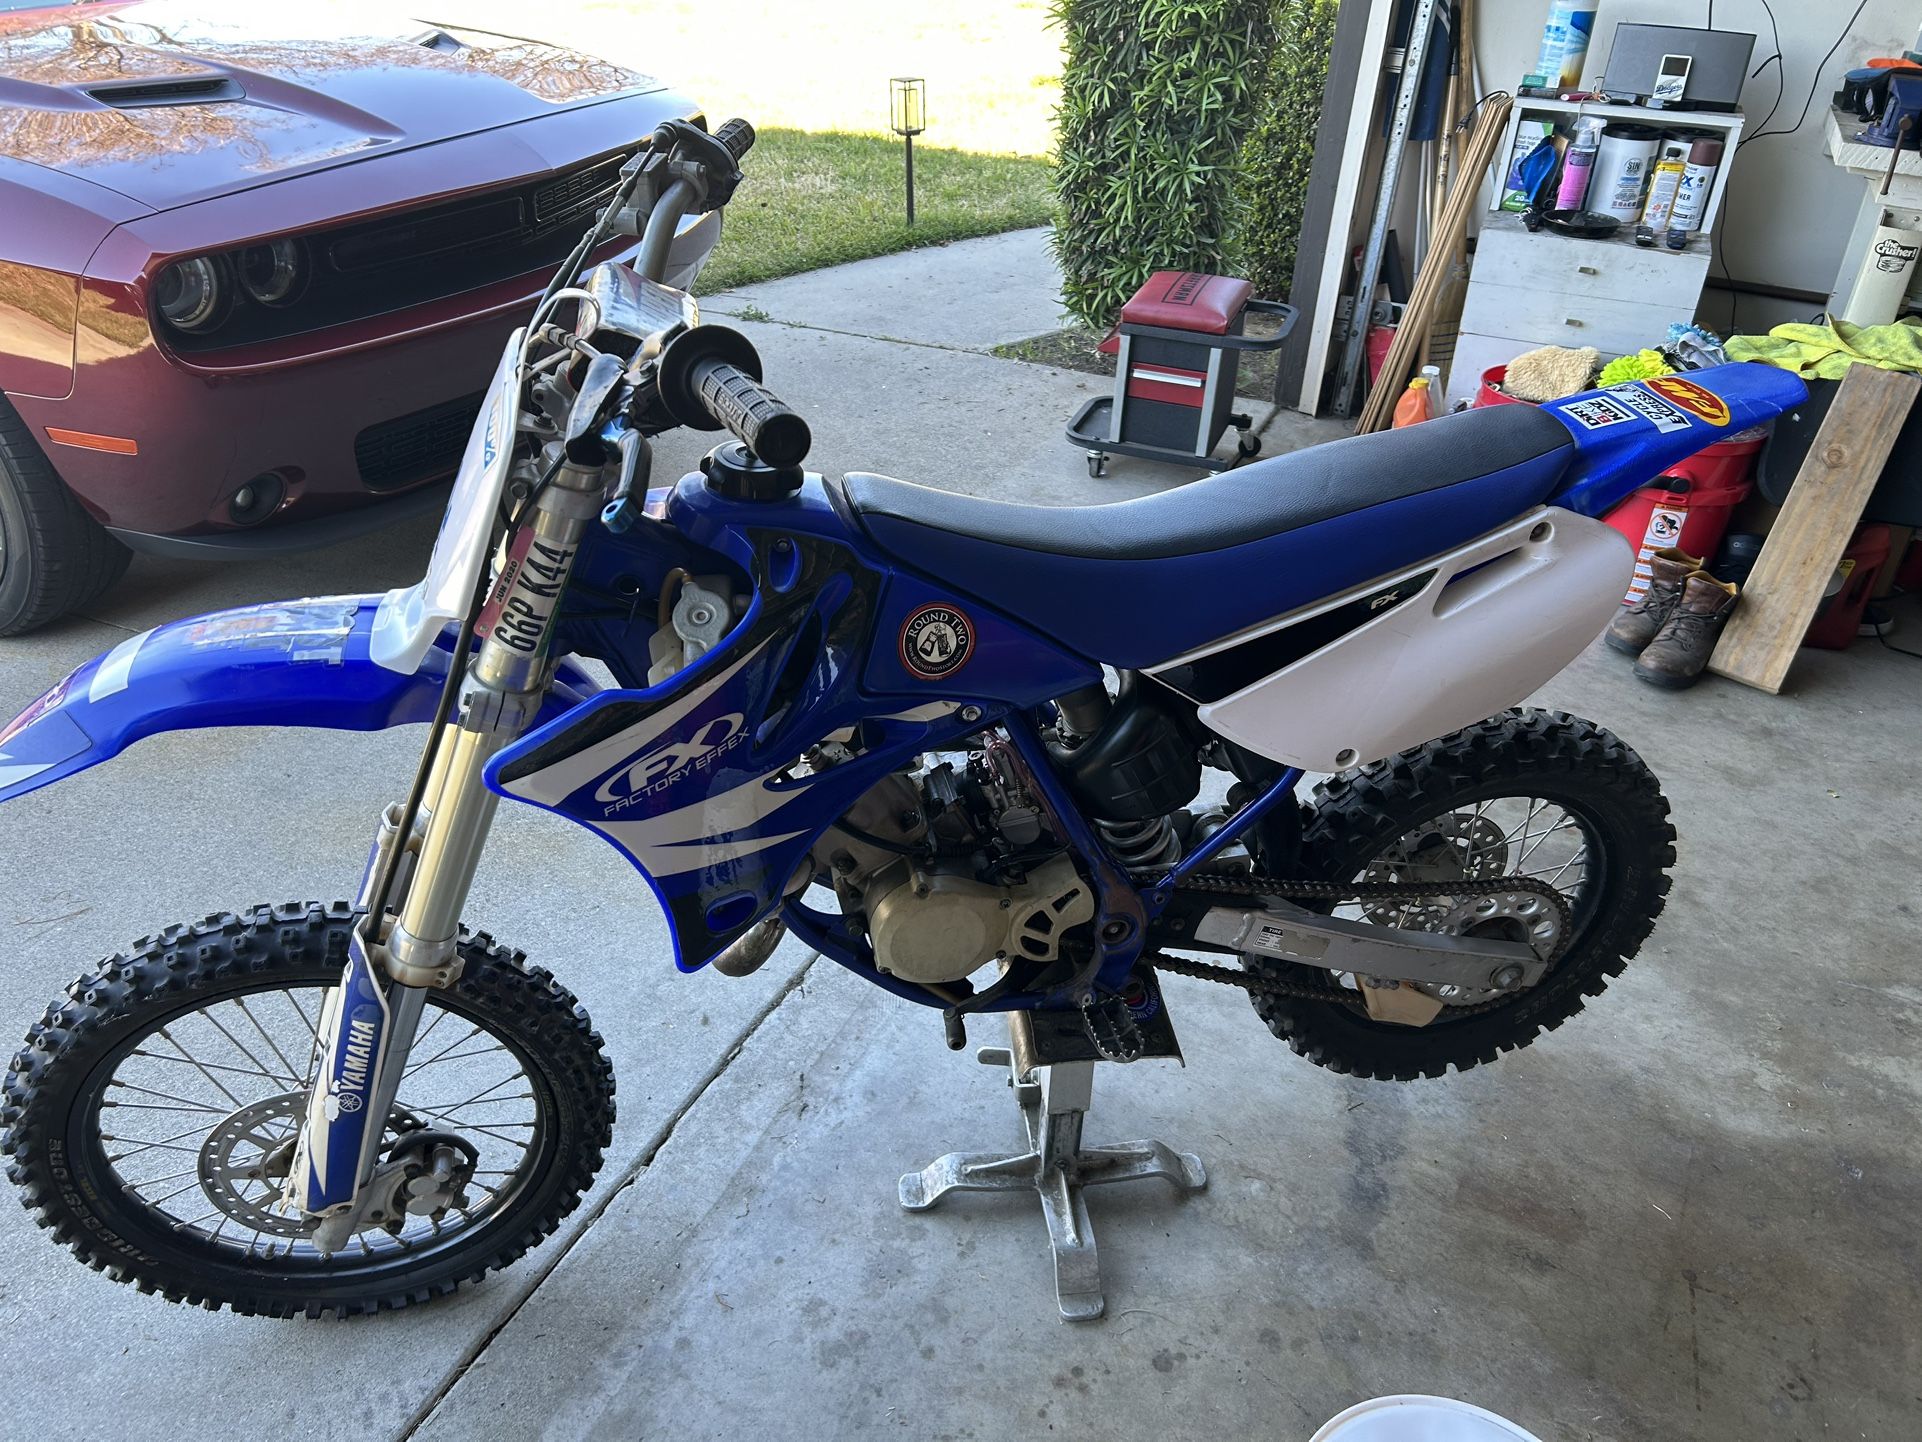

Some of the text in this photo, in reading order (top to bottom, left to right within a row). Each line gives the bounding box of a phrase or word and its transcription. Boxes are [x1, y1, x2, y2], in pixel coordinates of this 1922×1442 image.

[1656, 84, 1683, 95] Dodgers
[1876, 243, 1917, 258] Crusher!
[1884, 240, 1899, 249] the
[1624, 397, 1663, 420] CYCLE
[1653, 379, 1724, 417] FMF
[495, 560, 518, 602] JUN 2020
[517, 541, 574, 598] K44
[494, 596, 548, 652] 66P
[908, 612, 967, 645] ROUND TWO
[604, 726, 750, 817] FACTORY EFFEX
[629, 721, 717, 792] FX
[340, 1019, 375, 1091] YAMAHA
